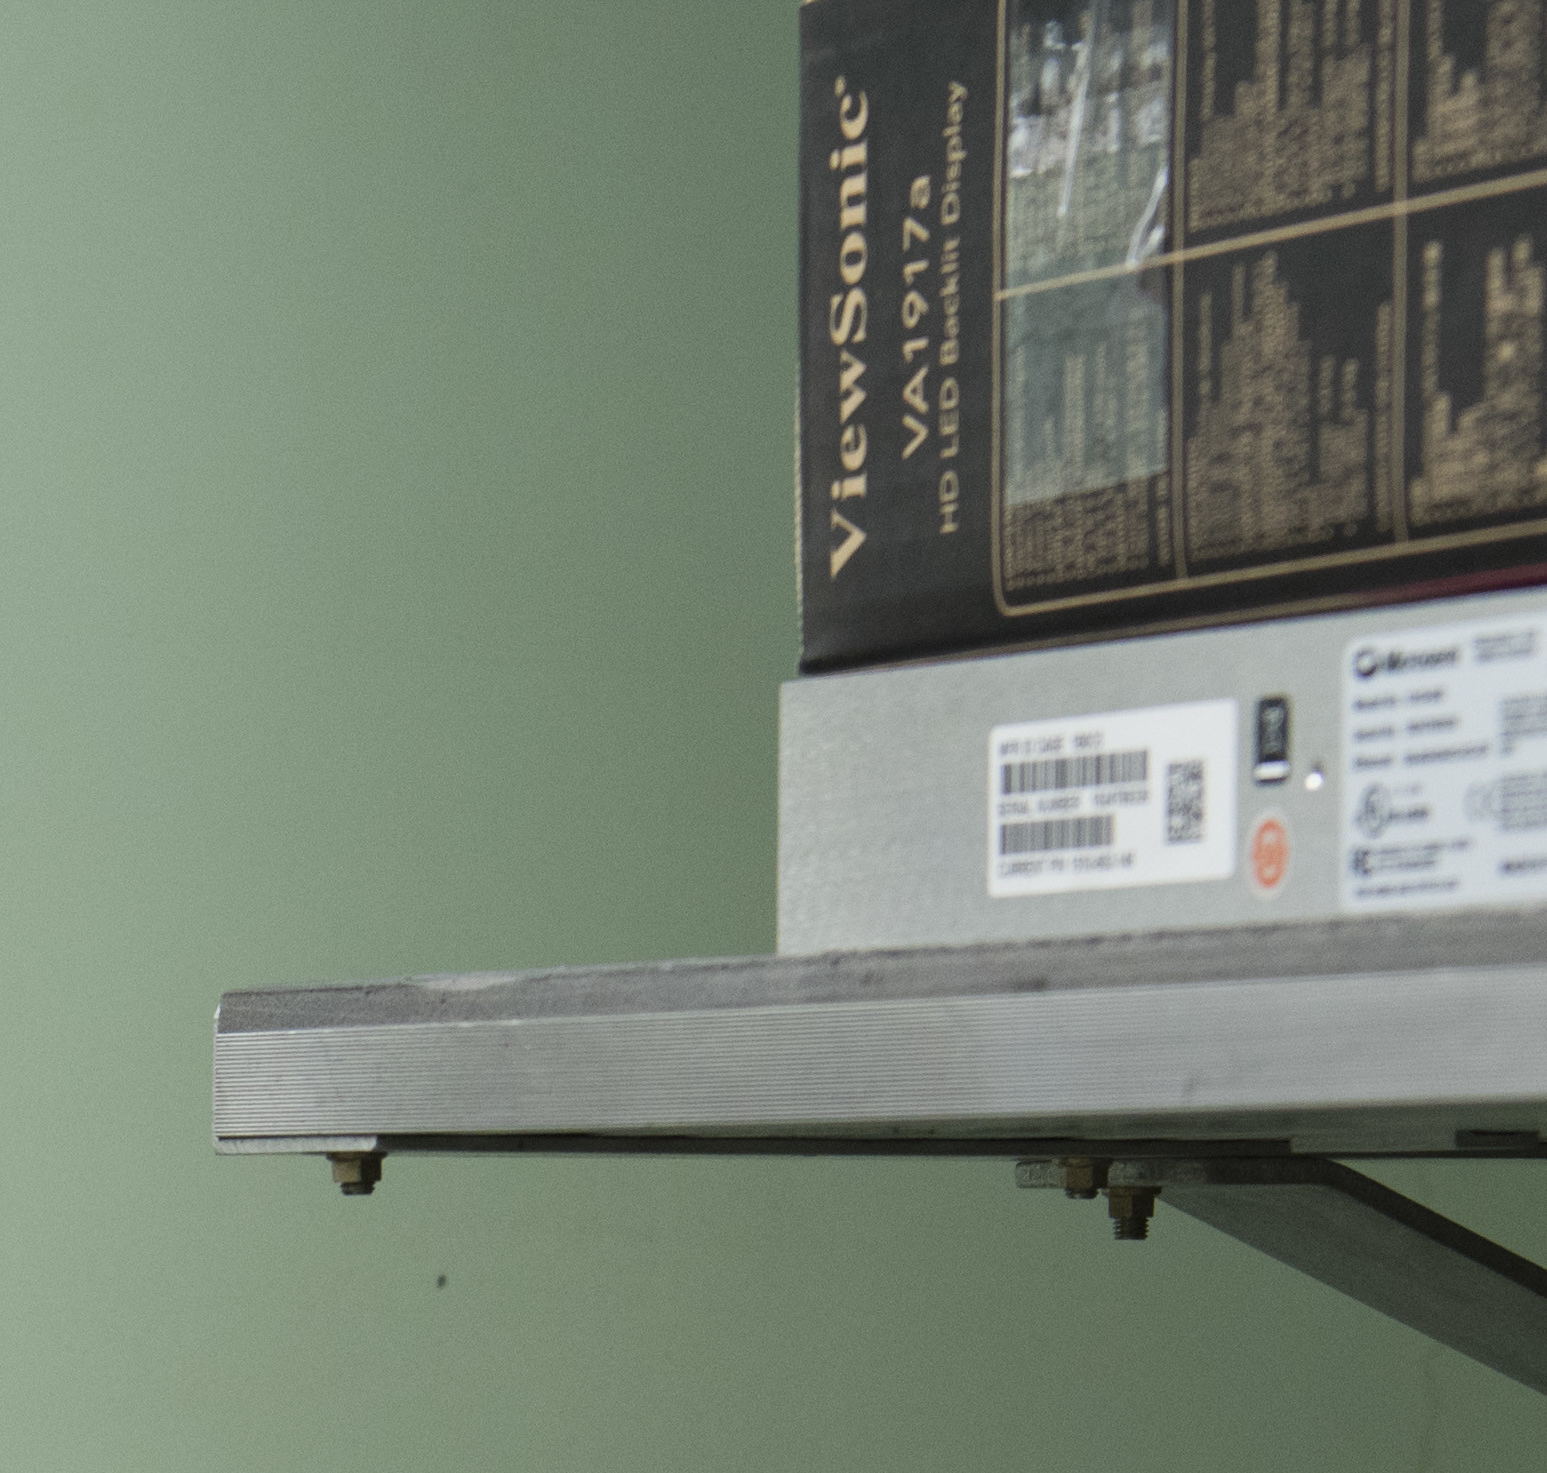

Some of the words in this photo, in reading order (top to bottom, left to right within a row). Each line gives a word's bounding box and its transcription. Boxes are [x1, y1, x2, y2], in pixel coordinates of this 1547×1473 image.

[940, 80, 968, 226] Display
[829, 86, 869, 582] ViewSonic
[902, 174, 931, 459] VA1917a
[939, 236, 961, 366] Backlit
[939, 377, 961, 460] LED
[939, 470, 961, 534] HD
